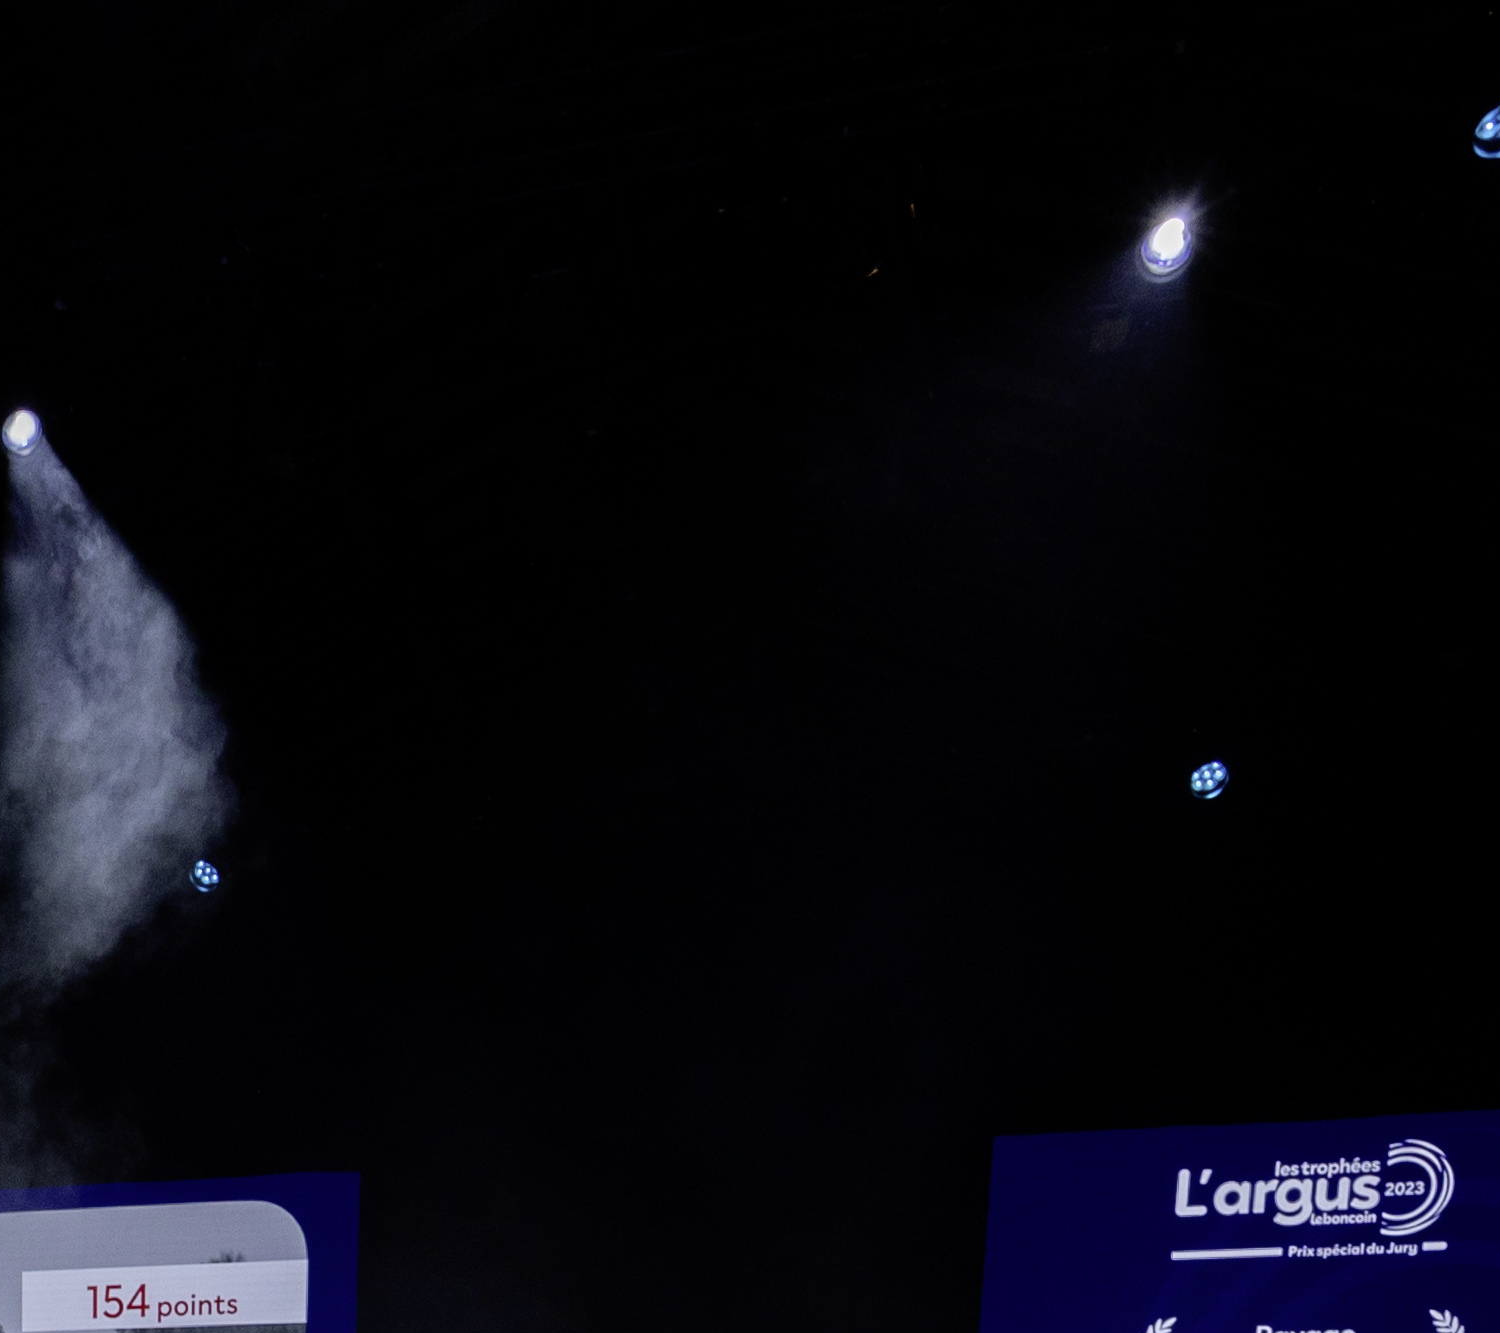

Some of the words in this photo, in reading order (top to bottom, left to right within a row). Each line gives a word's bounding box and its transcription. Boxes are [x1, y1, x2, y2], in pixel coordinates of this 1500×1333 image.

[1274, 1160, 1300, 1177] les
[1301, 1156, 1381, 1178] trophées
[1174, 1168, 1381, 1226] L'argus
[1384, 1180, 1425, 1196] 2023
[1310, 1210, 1377, 1226] leboncoin
[1288, 1245, 1315, 1258] Prix
[1316, 1242, 1365, 1259] spécial
[1366, 1242, 1384, 1255] du
[1386, 1241, 1419, 1257] Jury
[87, 1283, 150, 1319] 154
[157, 1293, 238, 1323] points
